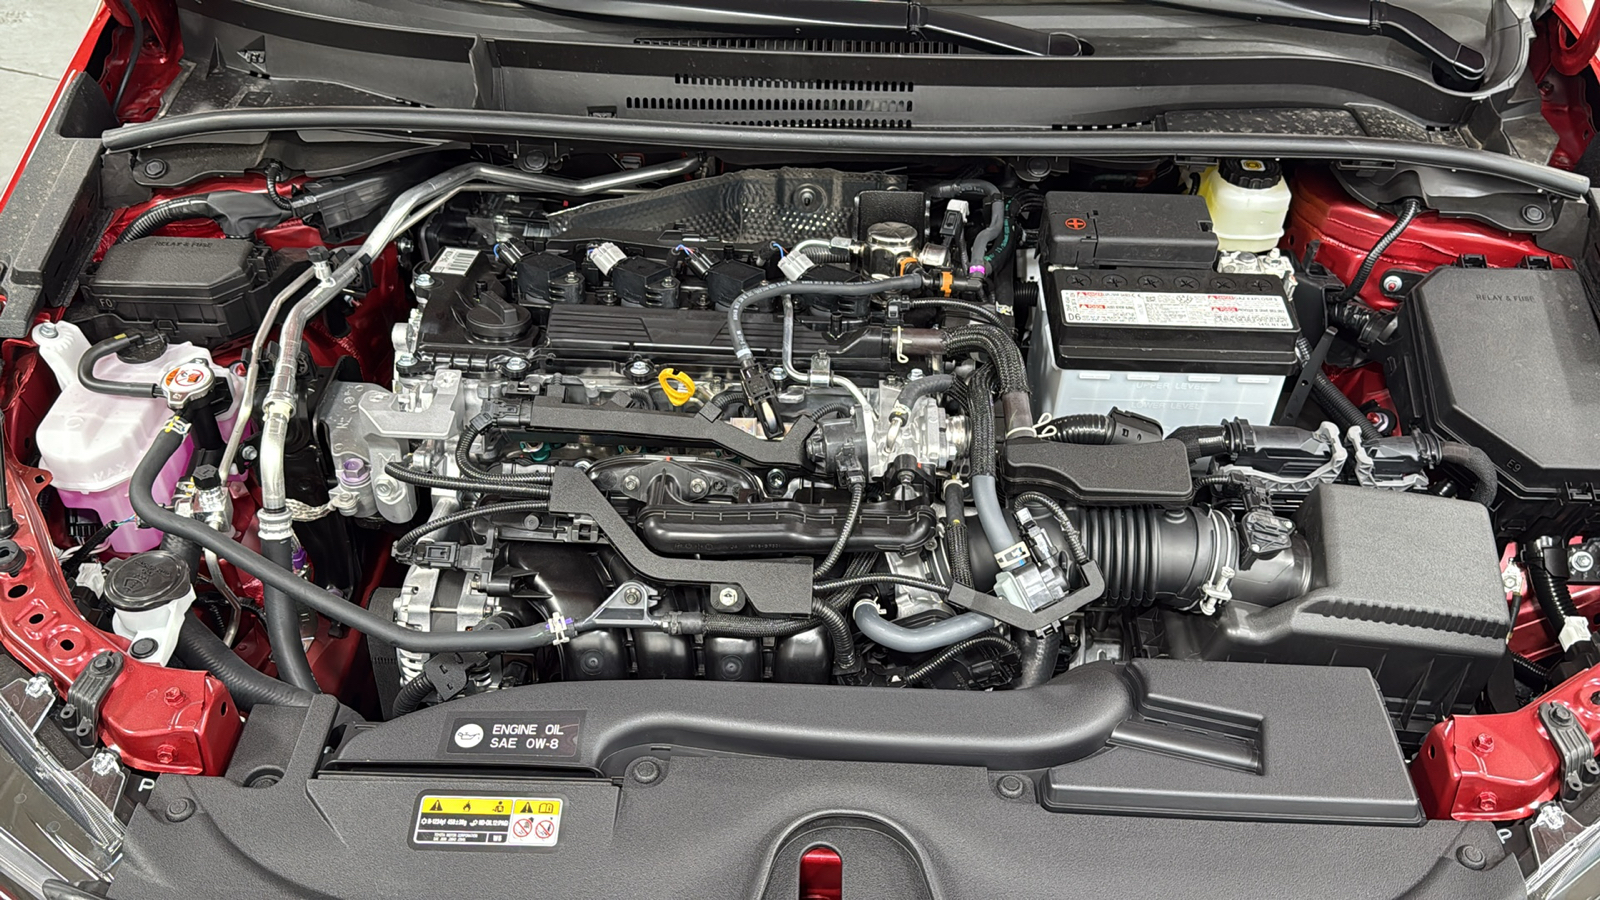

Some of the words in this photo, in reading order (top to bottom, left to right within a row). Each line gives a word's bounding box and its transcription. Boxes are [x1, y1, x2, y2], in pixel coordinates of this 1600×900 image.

[1068, 313, 1081, 321] D6
[1136, 381, 1170, 389] UPPER
[1174, 382, 1207, 390] LEVEL
[1131, 401, 1166, 409] LOWER
[1170, 402, 1201, 410] LEVEL
[93, 461, 128, 482] MAX
[1506, 459, 1522, 473] E9
[492, 724, 538, 735] ENGINE
[545, 724, 564, 735] OIL
[489, 738, 518, 748] SAE
[525, 738, 559, 749] 0W-8
[138, 778, 155, 792] P
[1496, 828, 1512, 844] P
